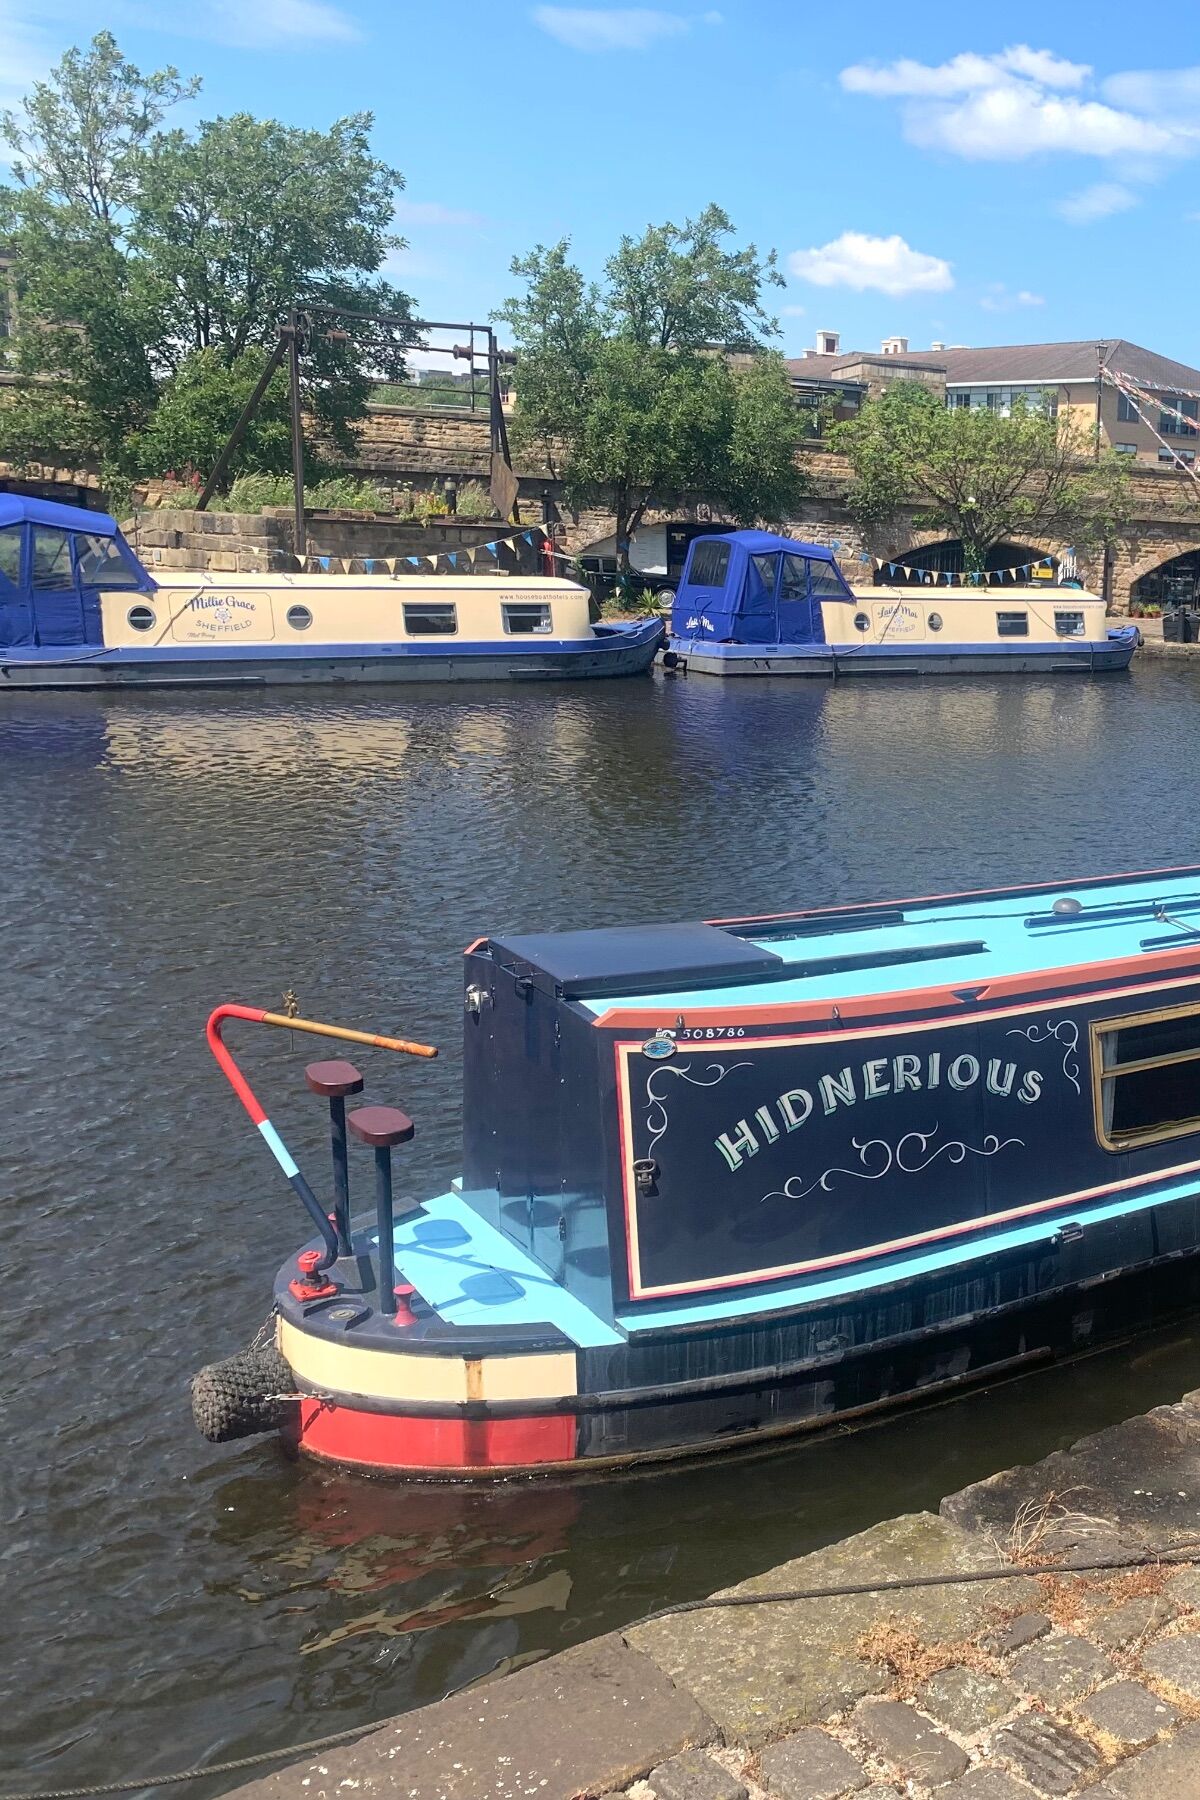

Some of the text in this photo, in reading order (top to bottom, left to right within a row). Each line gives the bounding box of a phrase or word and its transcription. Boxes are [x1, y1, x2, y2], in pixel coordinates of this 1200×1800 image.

[185, 595, 256, 612] Millie Grace
[195, 619, 252, 633] SHEFFIELD
[681, 1027, 745, 1039] 508786
[714, 1052, 1044, 1172] HIDNERIOUS
